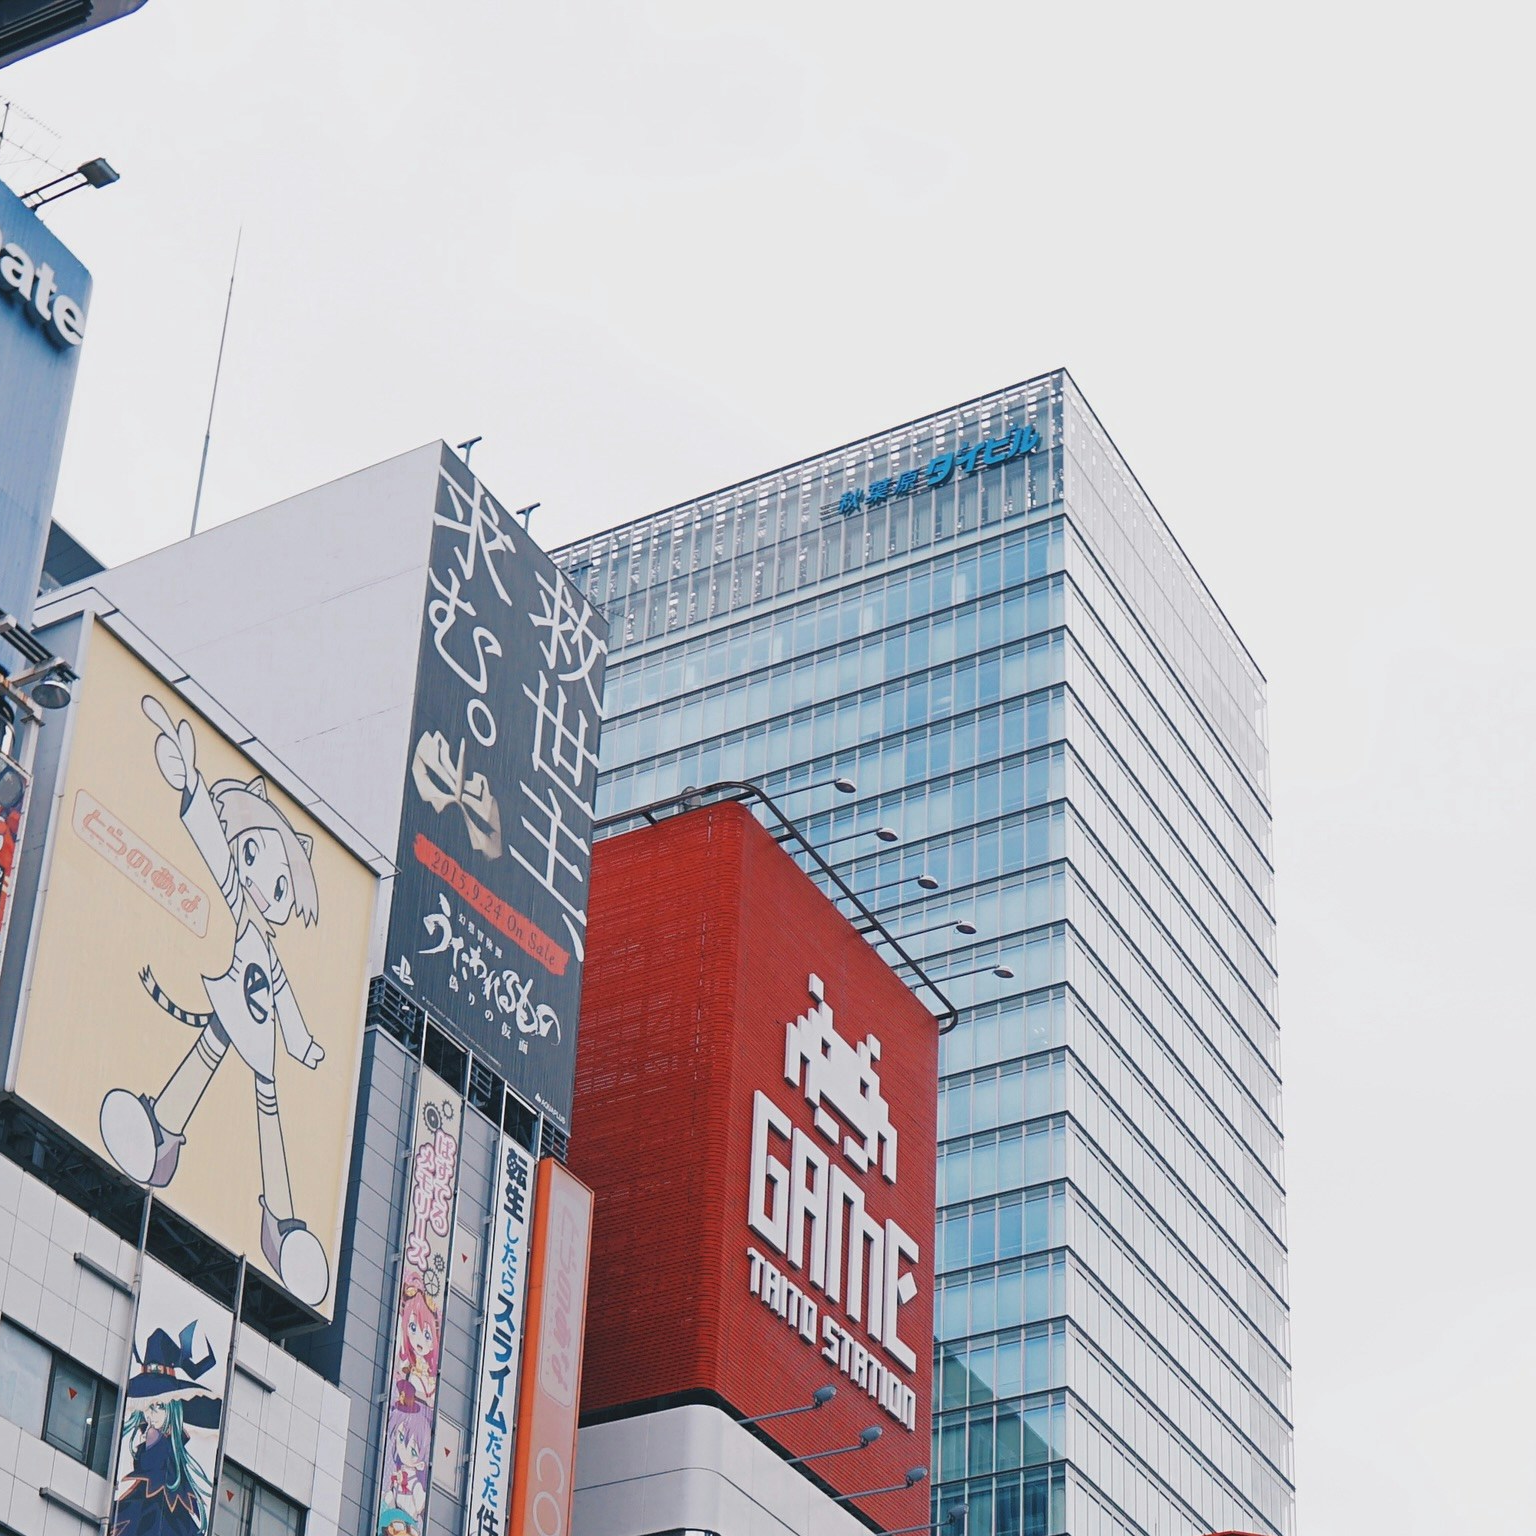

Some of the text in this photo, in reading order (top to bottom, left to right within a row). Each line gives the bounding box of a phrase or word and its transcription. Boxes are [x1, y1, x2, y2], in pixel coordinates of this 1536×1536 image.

[838, 424, 1042, 515] 秋葉原ダイビル
[79, 806, 204, 916] とらのあな
[430, 851, 557, 967] 2015.9.24 On Sale
[418, 891, 562, 1046] うたわれるもの
[748, 1089, 920, 1374] GAME
[747, 1247, 916, 1433] TAITO STATION
